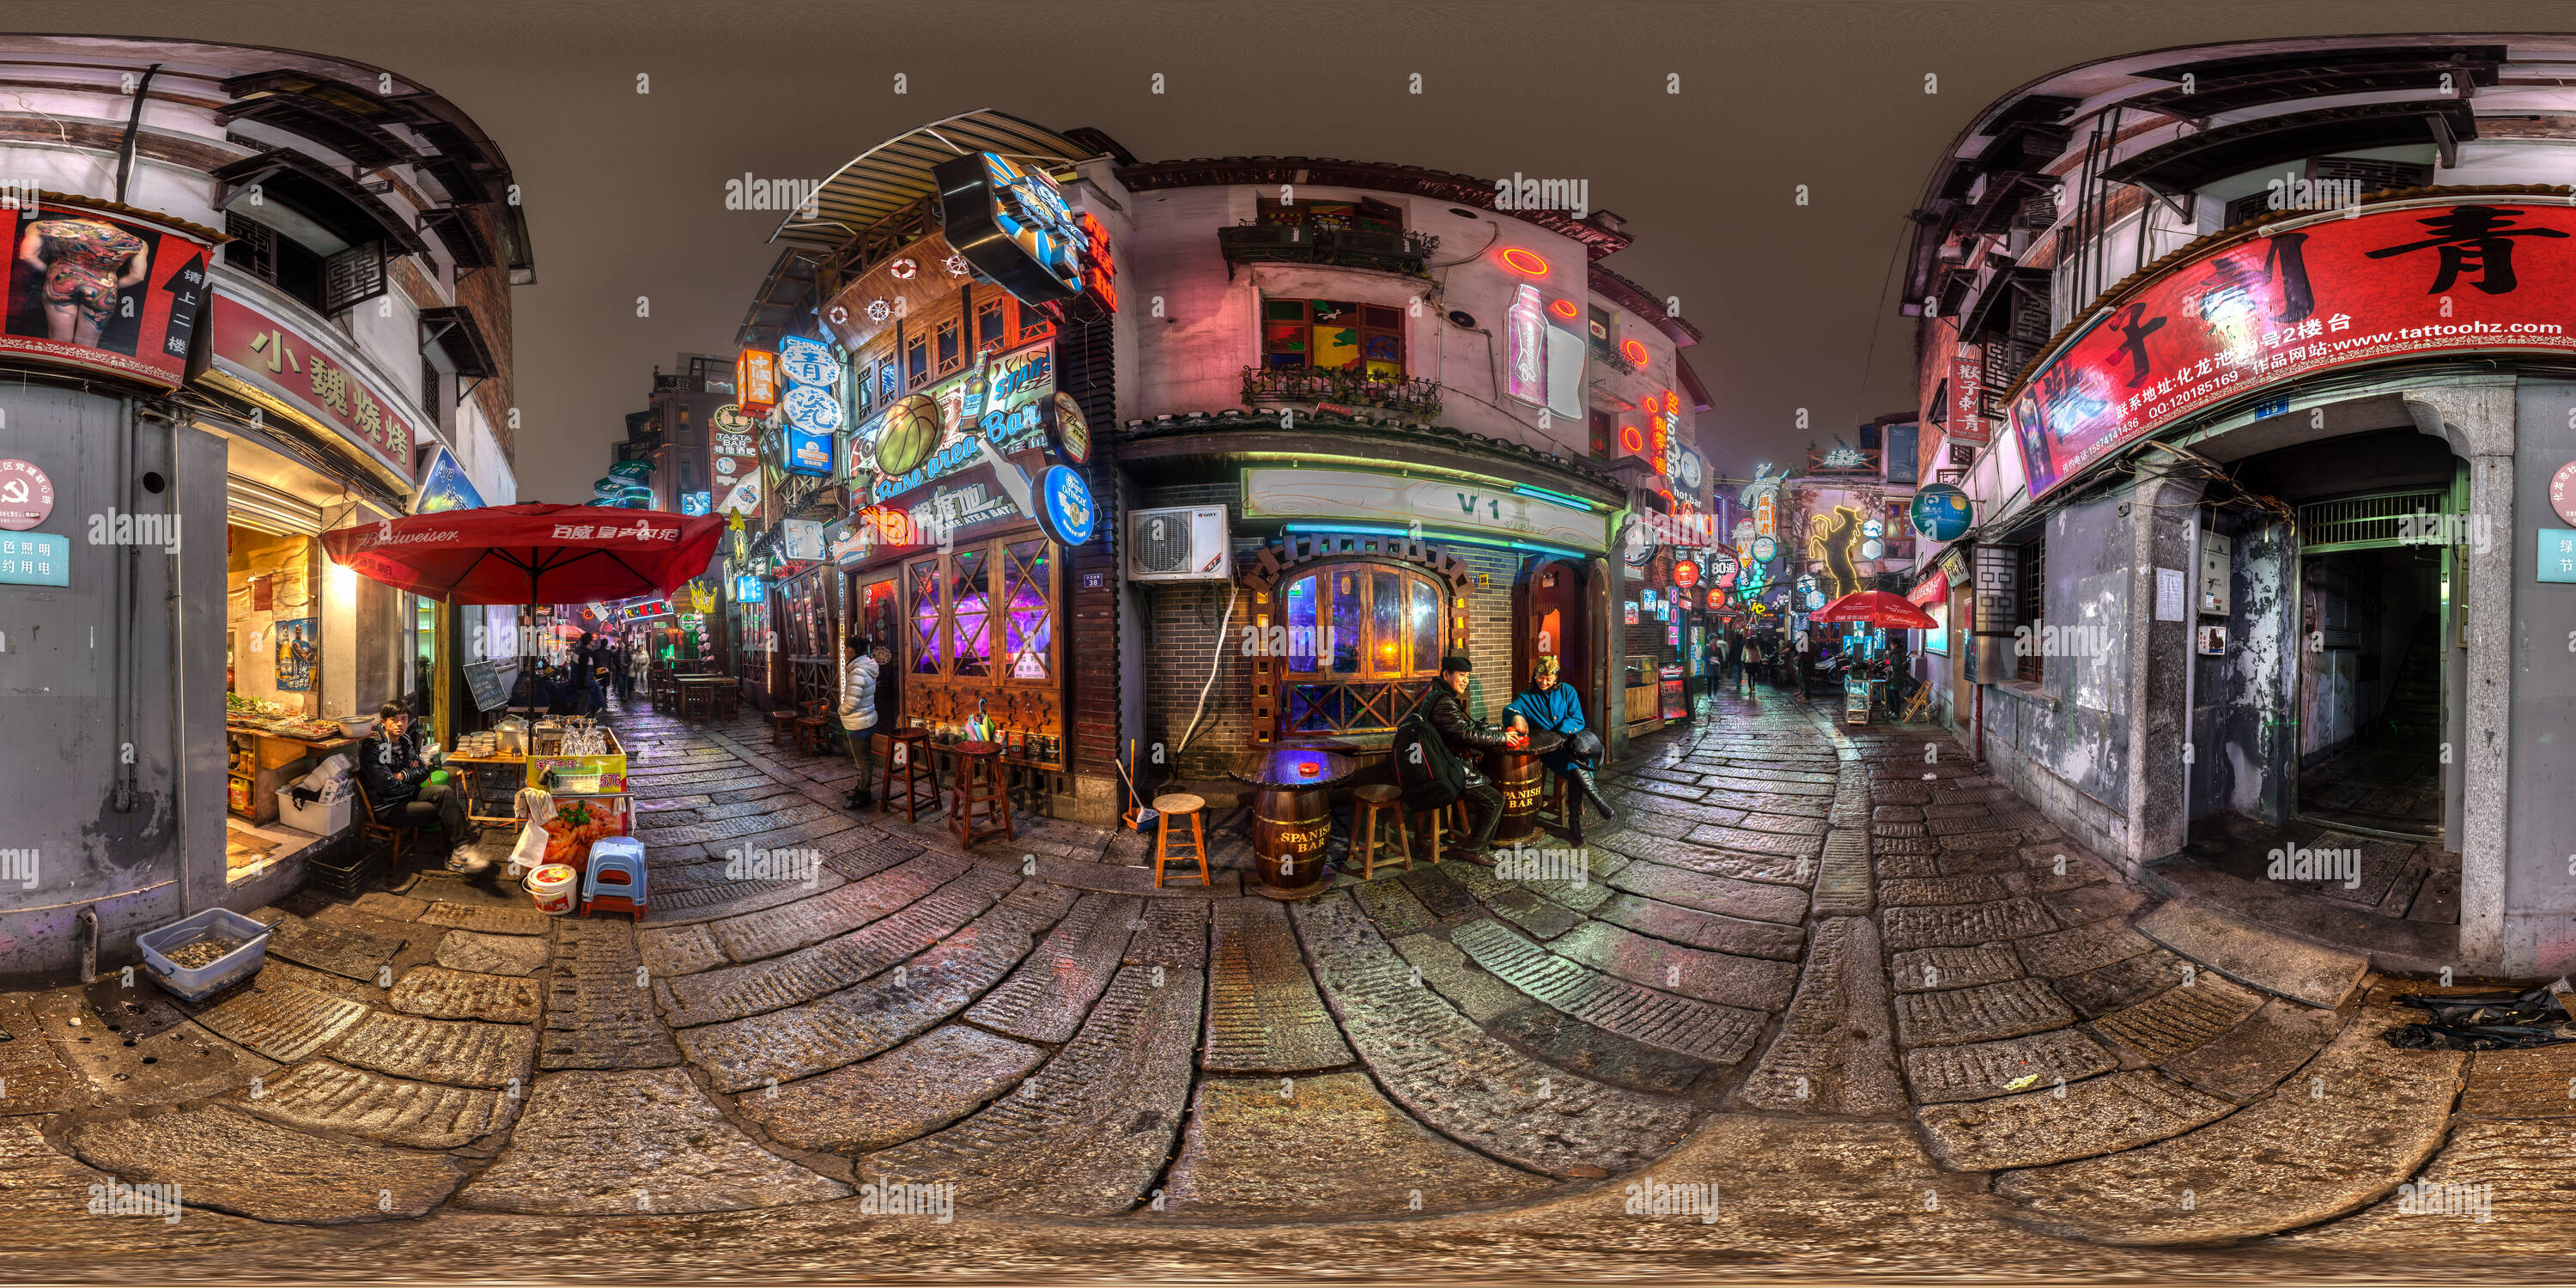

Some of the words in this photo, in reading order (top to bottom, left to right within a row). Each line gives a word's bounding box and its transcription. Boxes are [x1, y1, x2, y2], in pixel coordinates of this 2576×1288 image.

[167, 269, 203, 355] 请上二楼
[787, 339, 827, 352] CHINA
[250, 329, 408, 465] 小魏烧烤
[792, 352, 835, 428] 青瓷
[2148, 370, 2239, 418] QQ:120185169
[981, 405, 1042, 443] Bar
[716, 433, 752, 441] TA&TA
[434, 459, 455, 483] Aya
[876, 468, 923, 502] Base
[928, 436, 980, 478] area
[1674, 486, 1701, 508] hot.bar
[3, 540, 51, 556] 色照明
[2561, 540, 2573, 554] 绿
[2, 559, 51, 574] 约用电
[2561, 559, 2573, 572] 节
[599, 774, 621, 787] 576
[1504, 786, 1541, 800] PANISH
[1509, 798, 1534, 809] BAR
[1297, 838, 1325, 853] BAR
